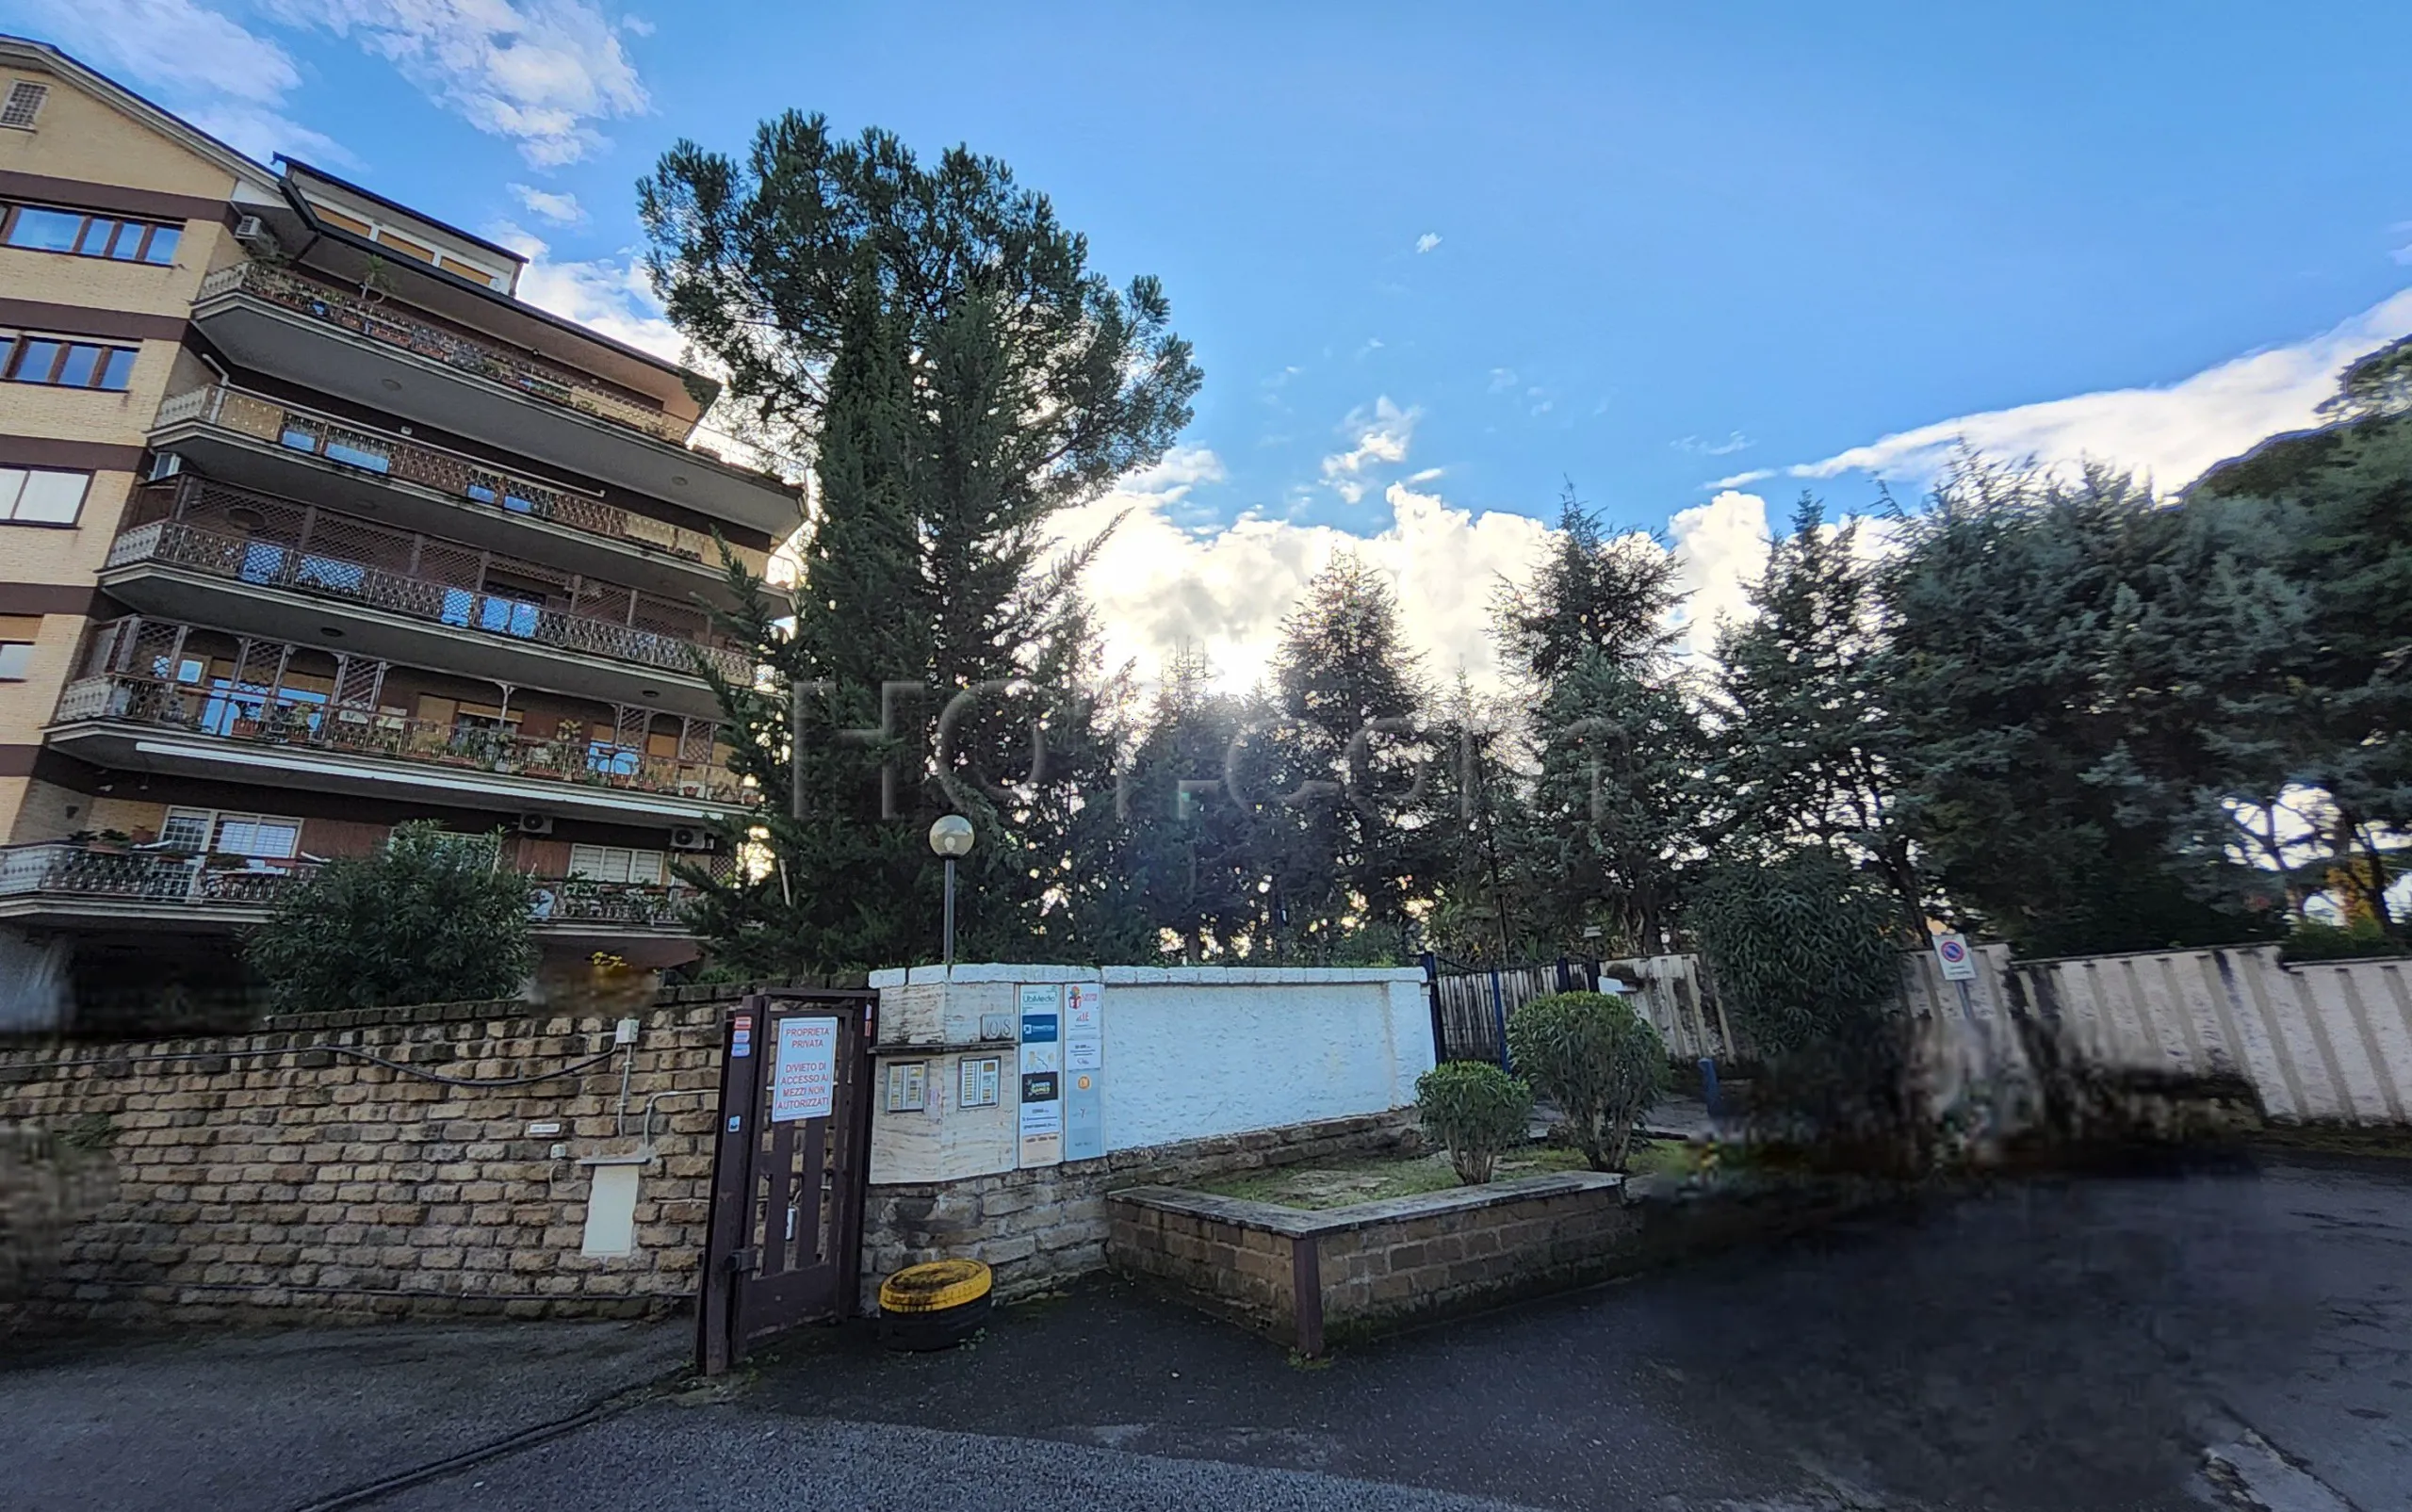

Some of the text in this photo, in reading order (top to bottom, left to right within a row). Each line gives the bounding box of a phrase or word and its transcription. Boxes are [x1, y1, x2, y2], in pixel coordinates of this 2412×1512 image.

[791, 1039, 824, 1049] PRIVATA
[785, 1062, 826, 1073] DIVIETO DI
[780, 1074, 829, 1085] ACCESSO AI
[783, 1085, 825, 1097] MEZZI NON
[776, 1097, 829, 1111] AUTORIZZATI
